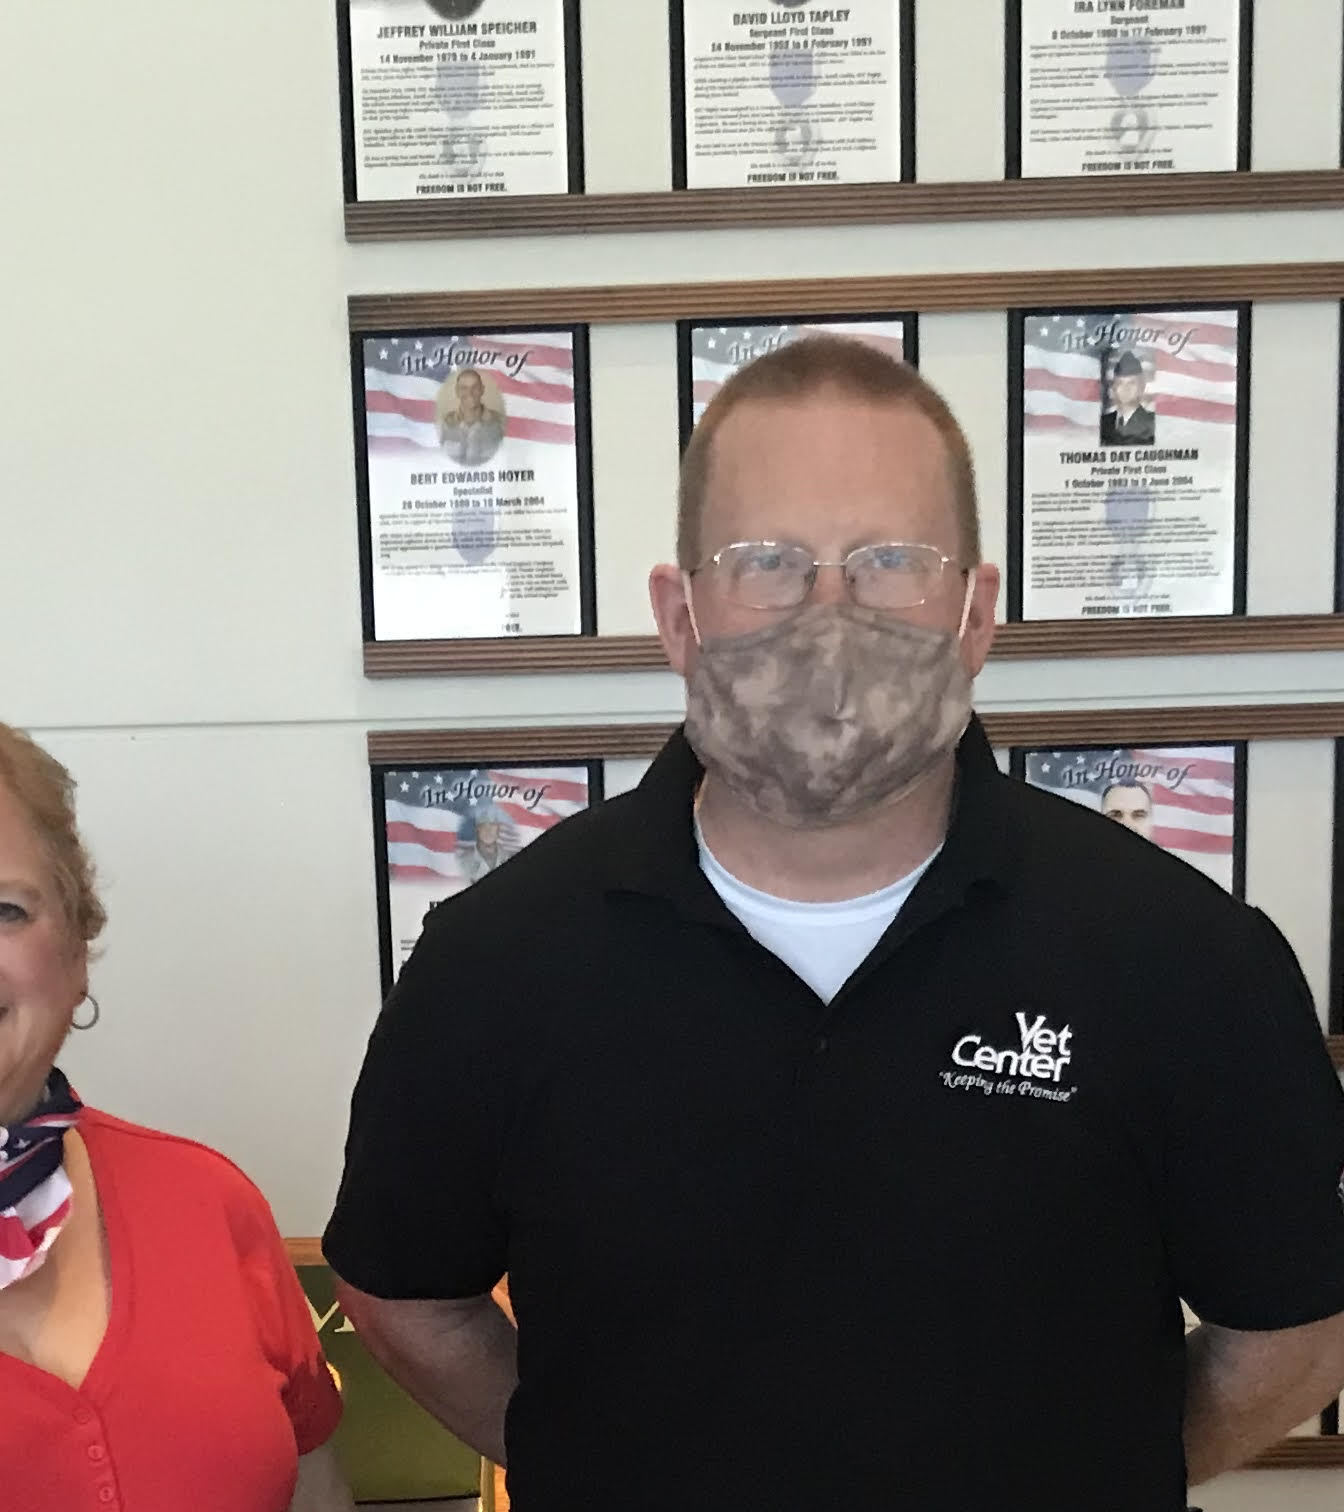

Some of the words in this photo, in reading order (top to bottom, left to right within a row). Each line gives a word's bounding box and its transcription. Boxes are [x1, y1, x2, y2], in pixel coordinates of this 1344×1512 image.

[733, 13, 767, 25] DAVID
[771, 11, 805, 24] LLOYD
[809, 9, 850, 22] TAPLEY
[377, 25, 424, 38] JEFFREY
[429, 23, 477, 37] WILLIAM
[481, 21, 537, 36] SPEICHER
[749, 29, 786, 38] Sergeant
[419, 40, 448, 50] Private
[451, 39, 470, 48] First
[725, 42, 765, 51] November
[811, 39, 848, 49] February
[393, 53, 433, 63] November
[479, 52, 512, 62] January
[1094, 321, 1165, 346] Honor
[1168, 328, 1199, 355] of
[402, 354, 427, 375] In
[431, 343, 502, 367] Honor
[506, 350, 535, 376] of
[1060, 451, 1106, 464] THOMAS
[411, 473, 437, 485] BERT
[442, 472, 494, 484] EDWARDS
[498, 470, 534, 482] HOYER
[1062, 769, 1088, 788] In
[1094, 757, 1161, 781] Honor
[1167, 764, 1196, 789] of
[424, 786, 447, 808] In
[453, 779, 519, 800] Honor
[523, 785, 551, 810] of
[1015, 1012, 1072, 1056] Vet
[952, 1034, 1071, 1082] Center
[996, 1079, 1016, 1095] the
